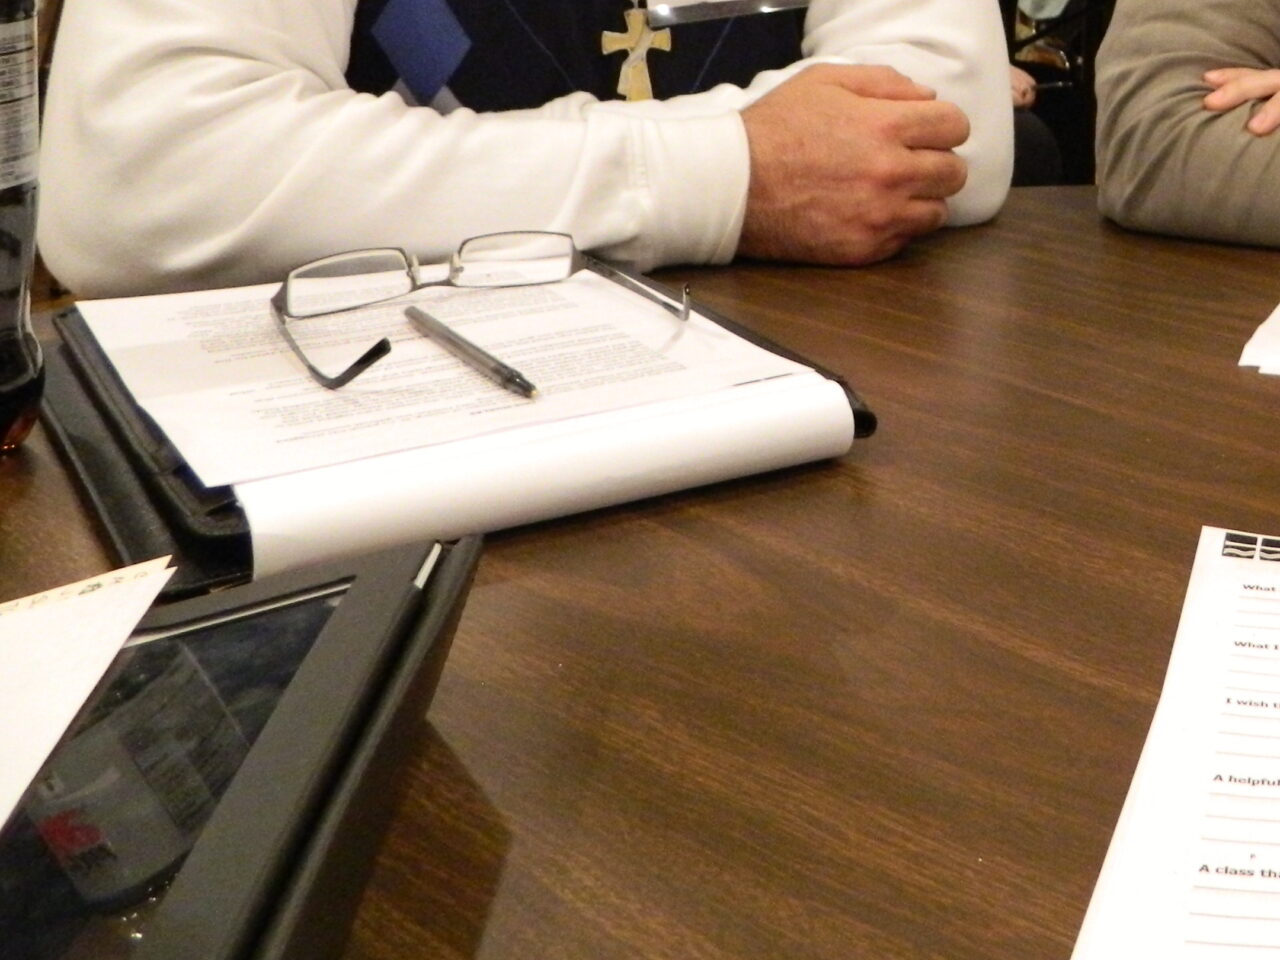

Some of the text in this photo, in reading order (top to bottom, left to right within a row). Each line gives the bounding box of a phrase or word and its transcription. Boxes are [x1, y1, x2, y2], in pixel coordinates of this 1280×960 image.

[1243, 584, 1276, 593] What
[1234, 640, 1269, 650] What
[1236, 699, 1269, 709] wish
[1213, 774, 1224, 782] A
[1228, 775, 1280, 787] helpful
[1199, 864, 1210, 873] A
[1215, 866, 1255, 877] class
